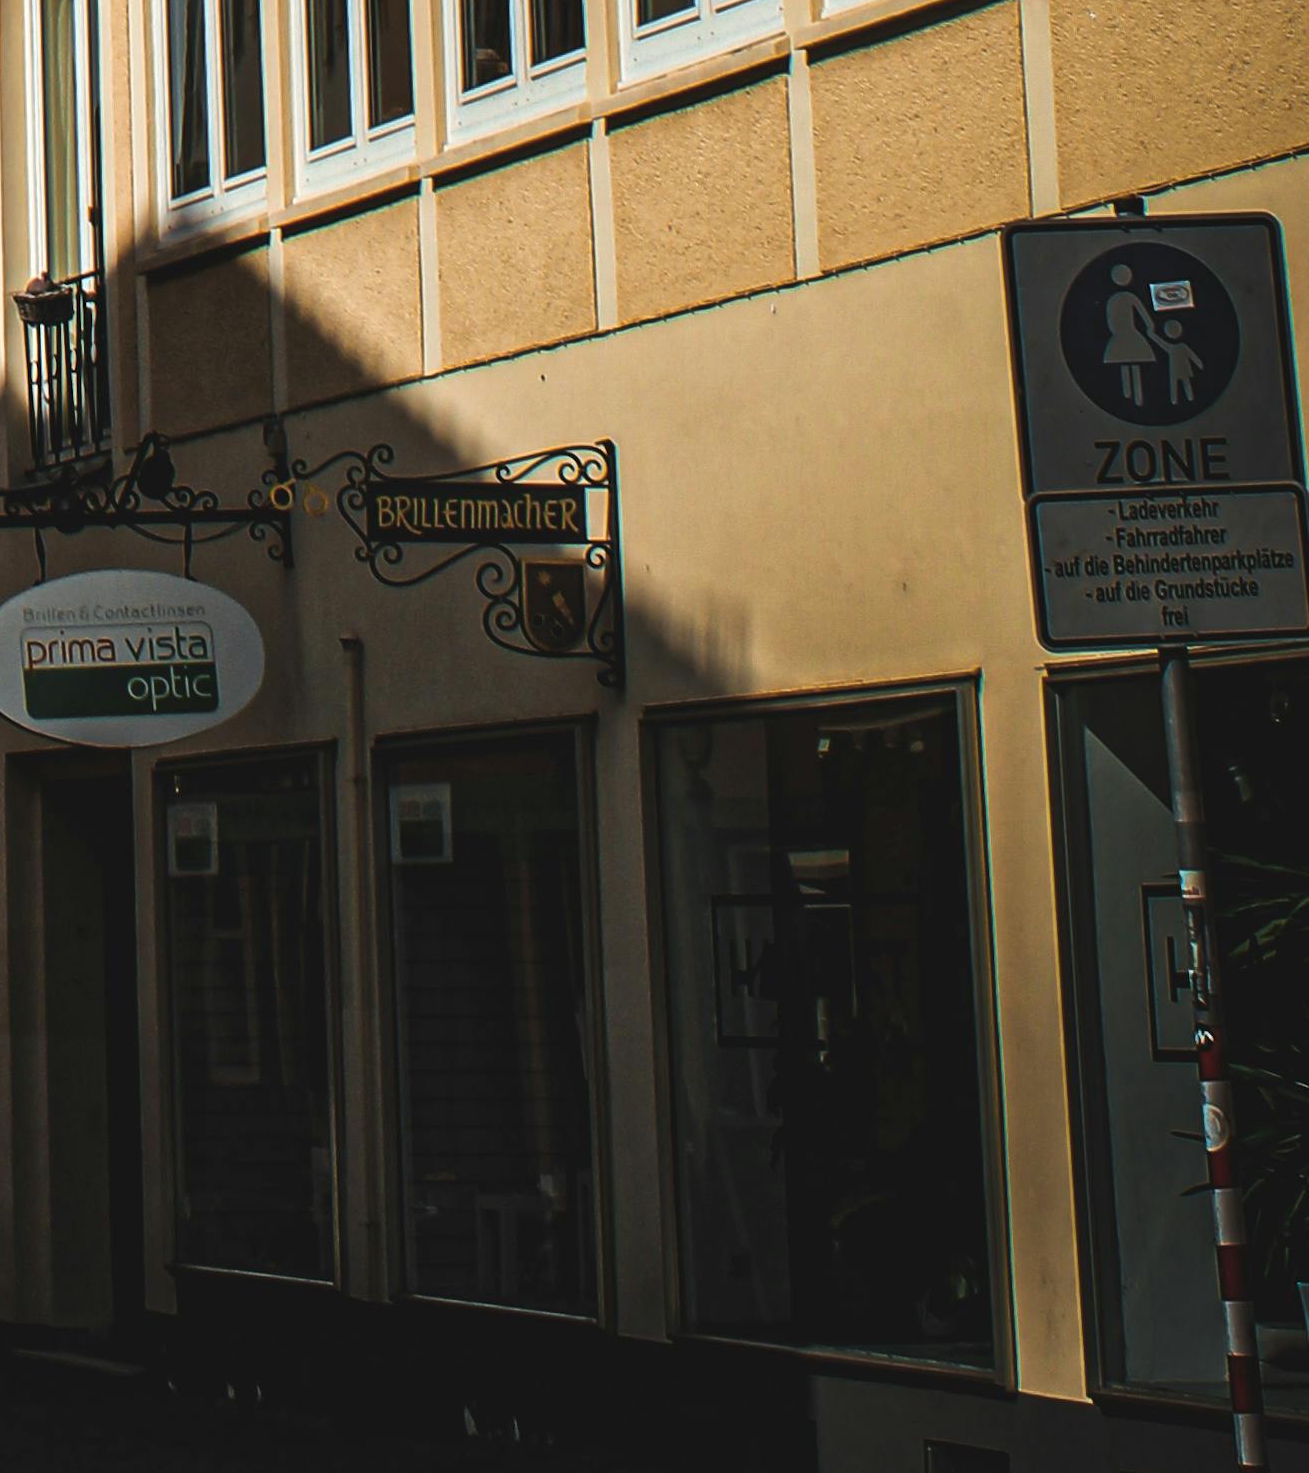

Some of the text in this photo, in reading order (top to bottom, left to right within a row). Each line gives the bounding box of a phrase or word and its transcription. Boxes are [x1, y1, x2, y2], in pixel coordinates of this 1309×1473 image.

[1093, 437, 1230, 484] ZONE
[1117, 497, 1220, 522] Ladeverkehr
[1115, 524, 1228, 549] Fahrradfahrer
[1054, 556, 1080, 578] auf
[1084, 555, 1109, 577] die
[1112, 547, 1296, 576] Behindertenparkplätze
[1096, 581, 1122, 603] auf
[1126, 581, 1151, 601] die
[1154, 576, 1260, 601] Grundstücke
[1161, 606, 1190, 627] frei
[26, 625, 209, 671] prima vista
[126, 664, 213, 713] optic
